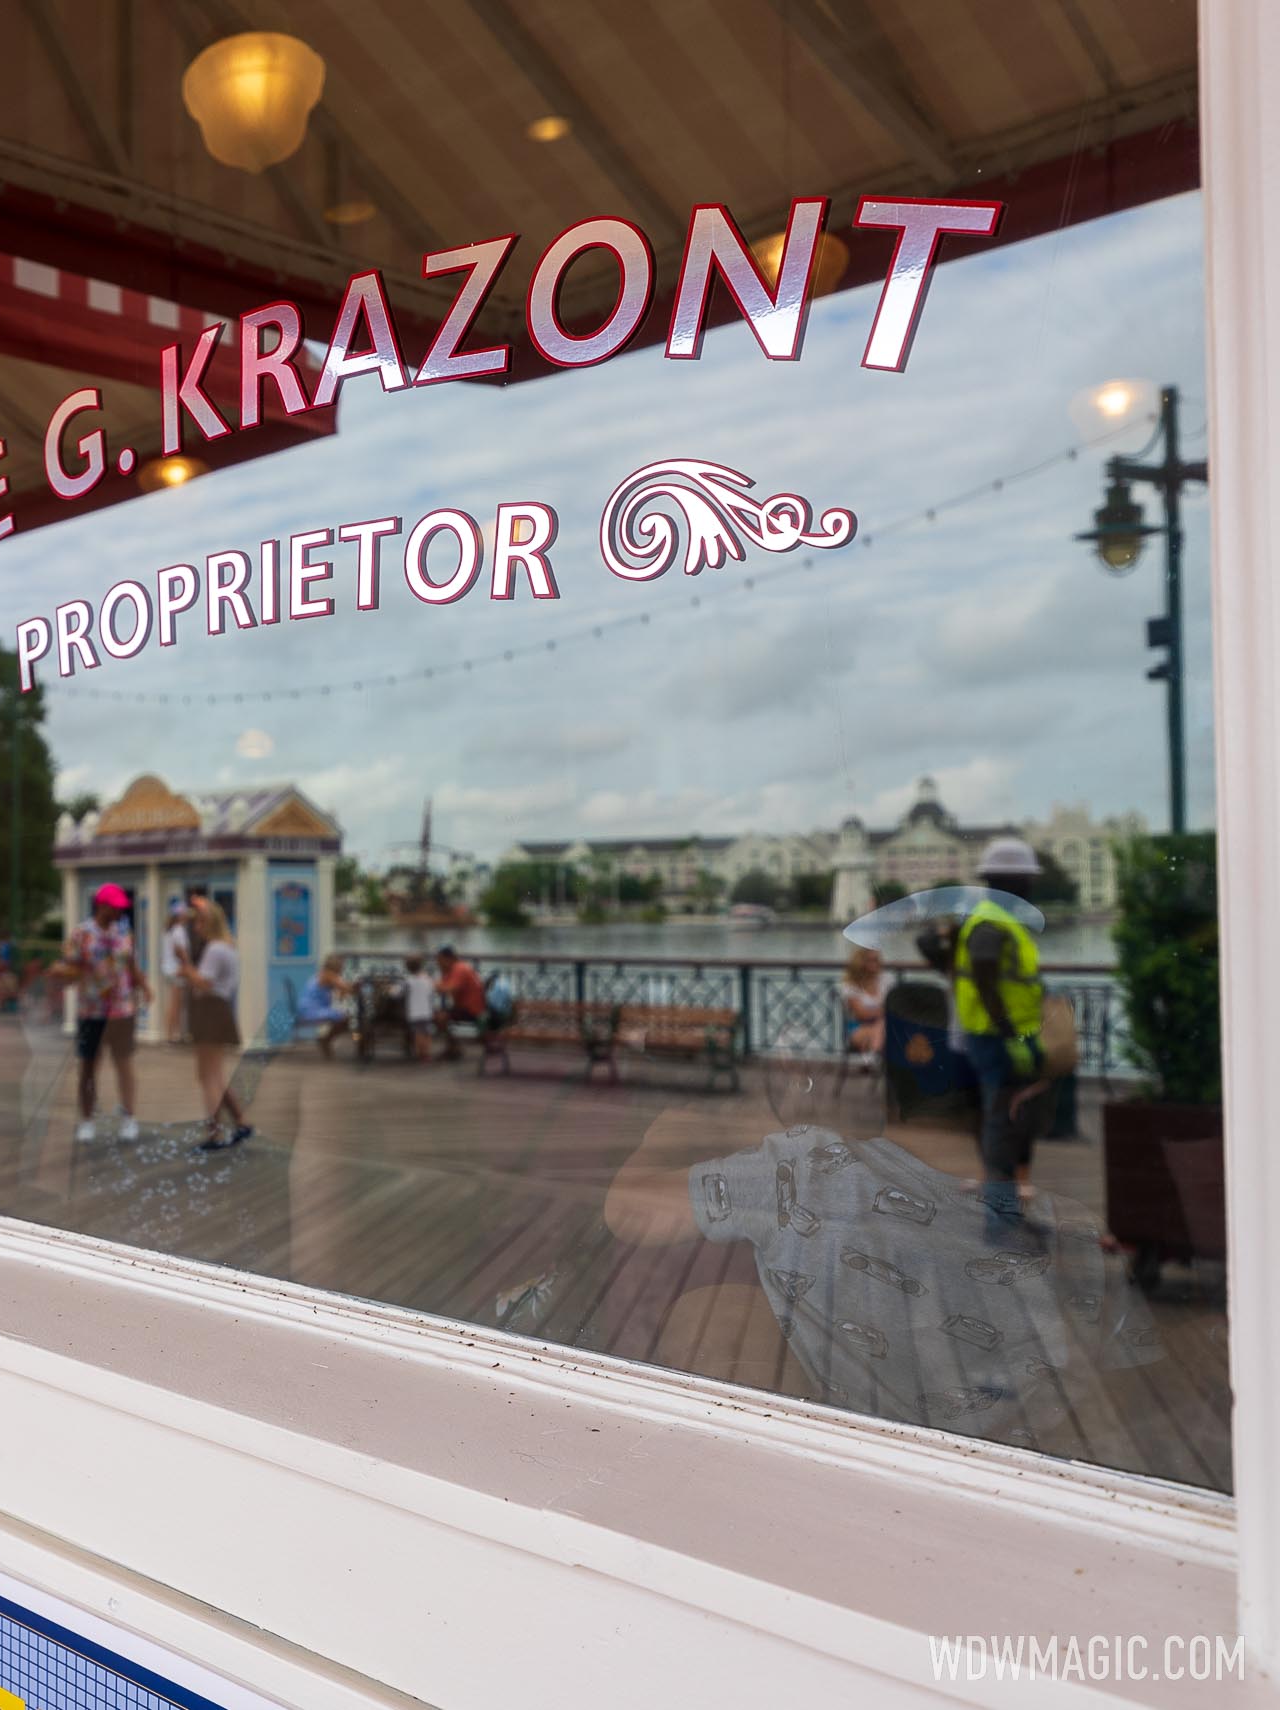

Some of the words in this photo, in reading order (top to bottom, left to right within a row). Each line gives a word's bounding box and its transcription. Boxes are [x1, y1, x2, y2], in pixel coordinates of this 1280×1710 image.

[44, 387, 138, 499] G.
[160, 194, 1006, 457] KRAZONT
[15, 501, 561, 693] PROPRIETOR
